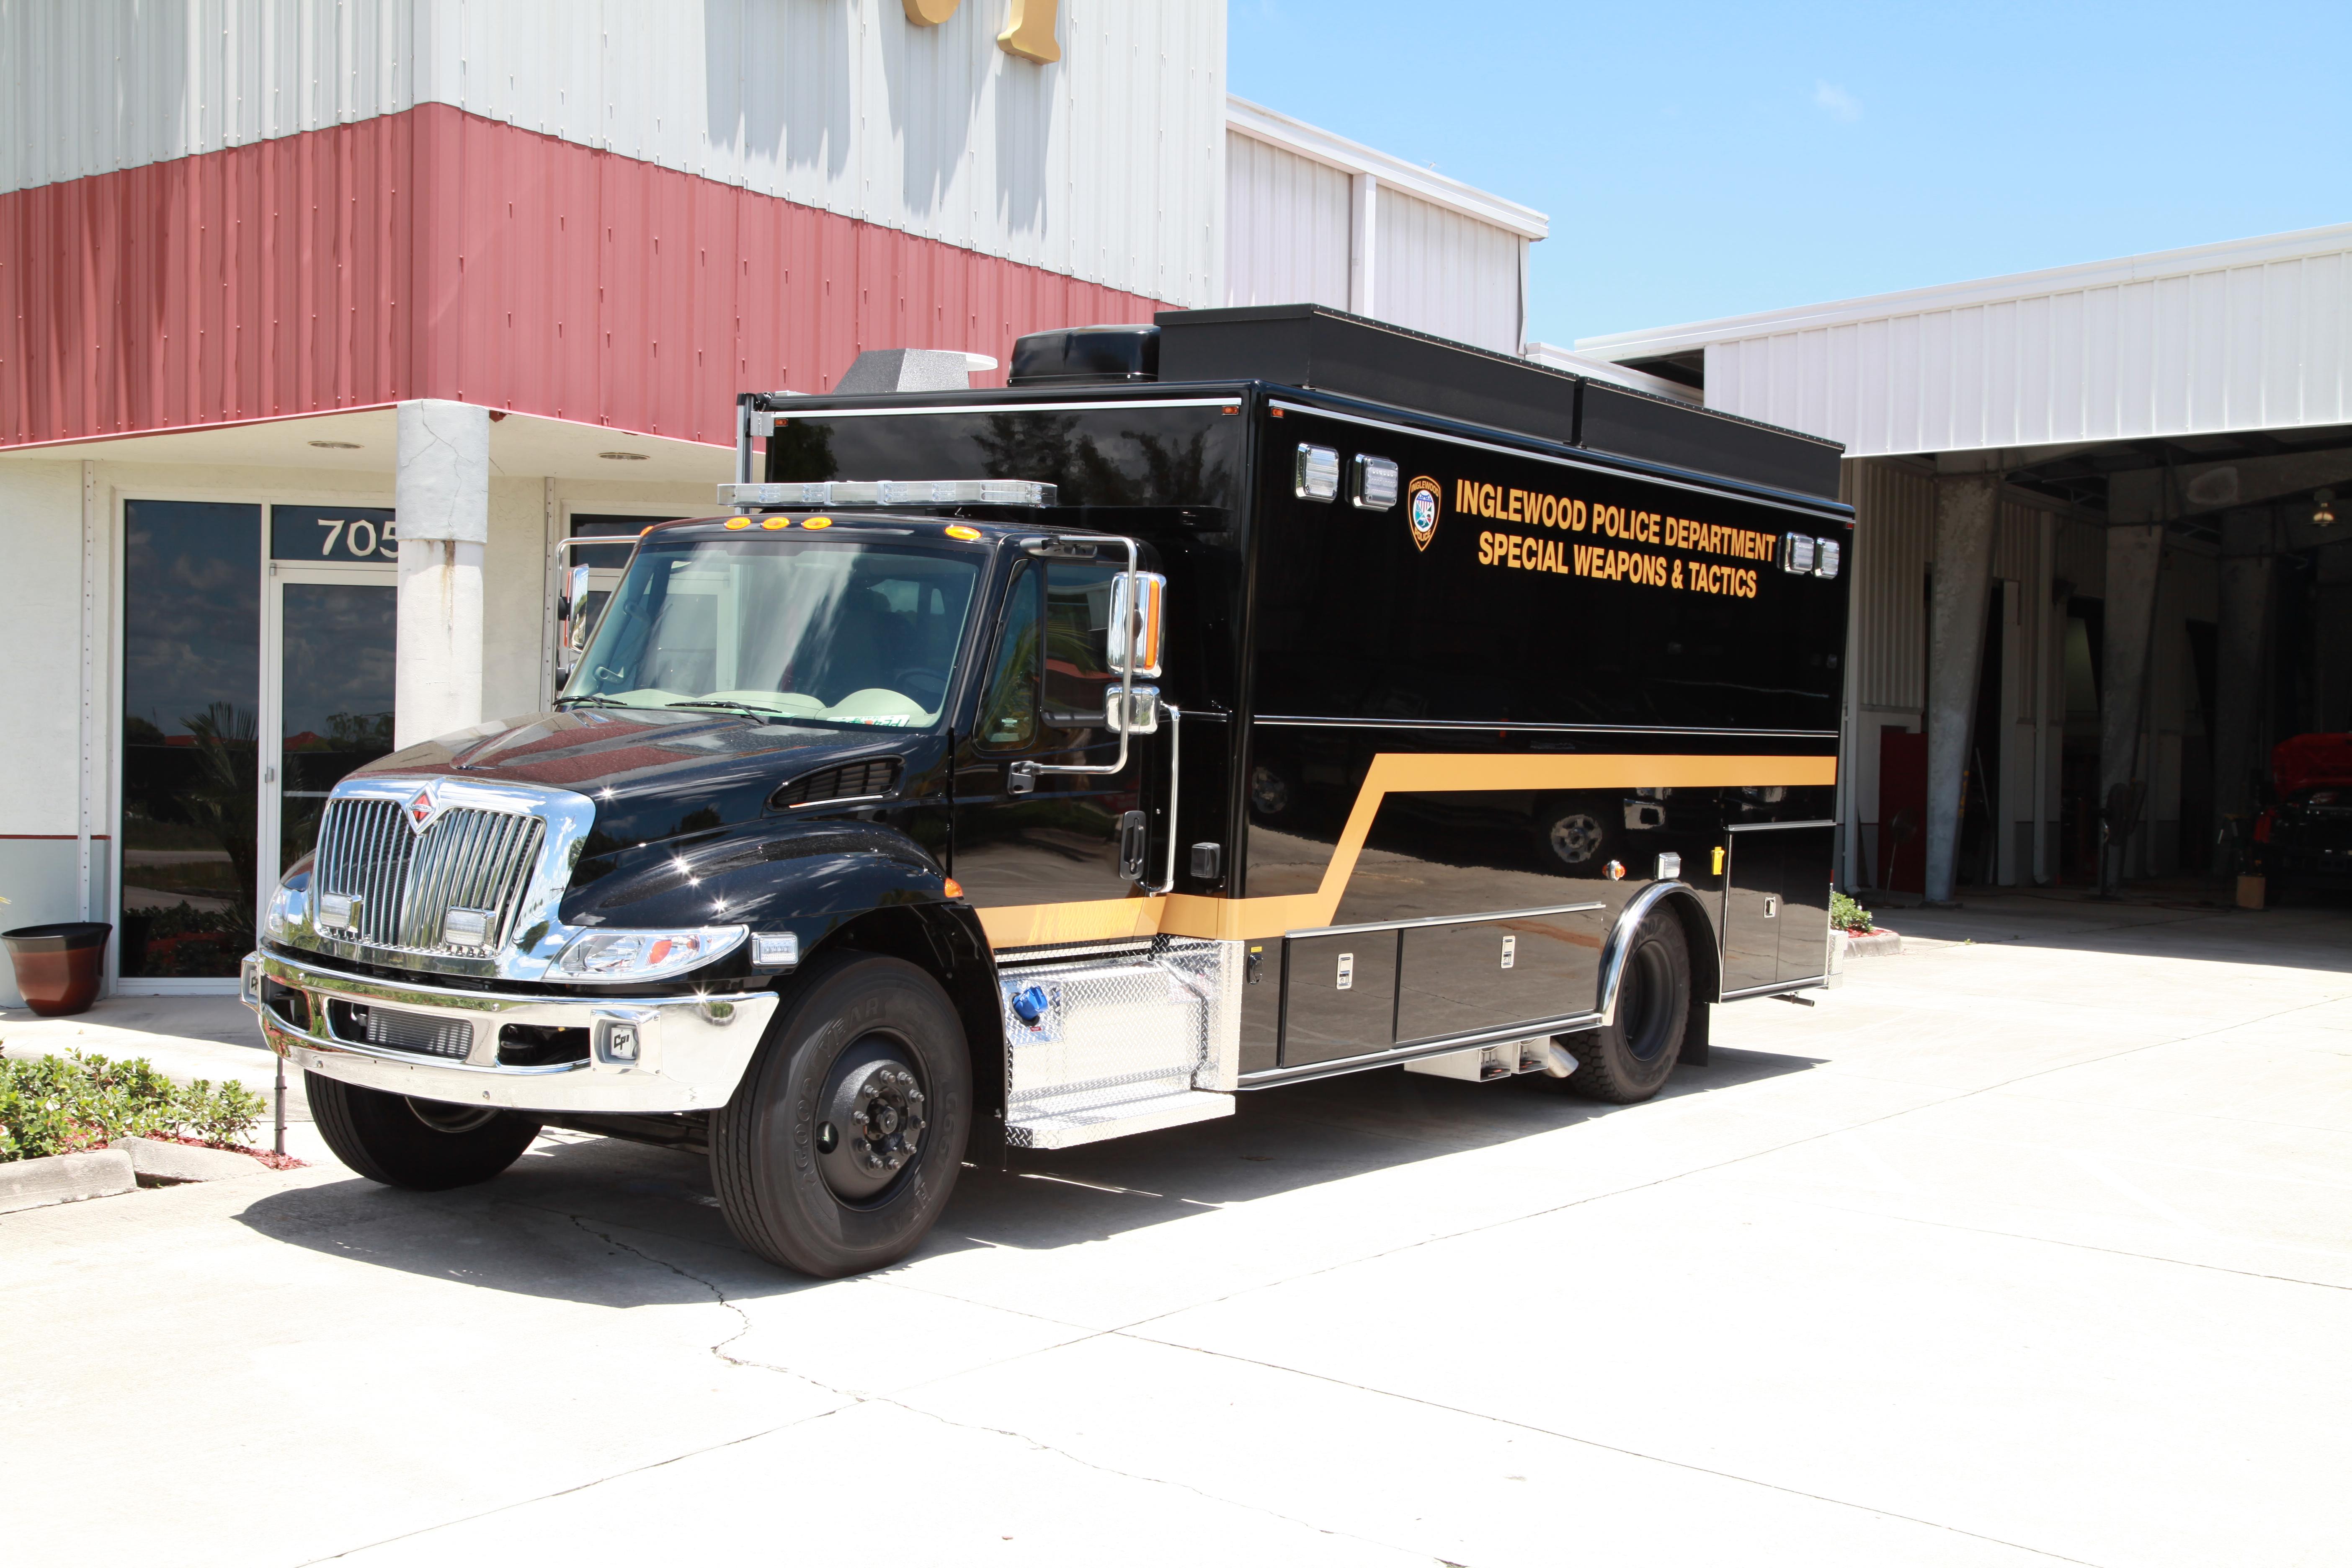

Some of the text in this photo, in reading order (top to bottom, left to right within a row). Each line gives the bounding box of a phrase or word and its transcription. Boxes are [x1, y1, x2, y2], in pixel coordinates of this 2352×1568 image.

[1411, 481, 1439, 497] INGLEWOOD
[1414, 526, 1431, 541] POLICE
[1456, 479, 1776, 562] INGLEWOOD POLICE DEPARTMENT
[1478, 531, 1757, 598] SPECIAL WEAPONS & TACTICS
